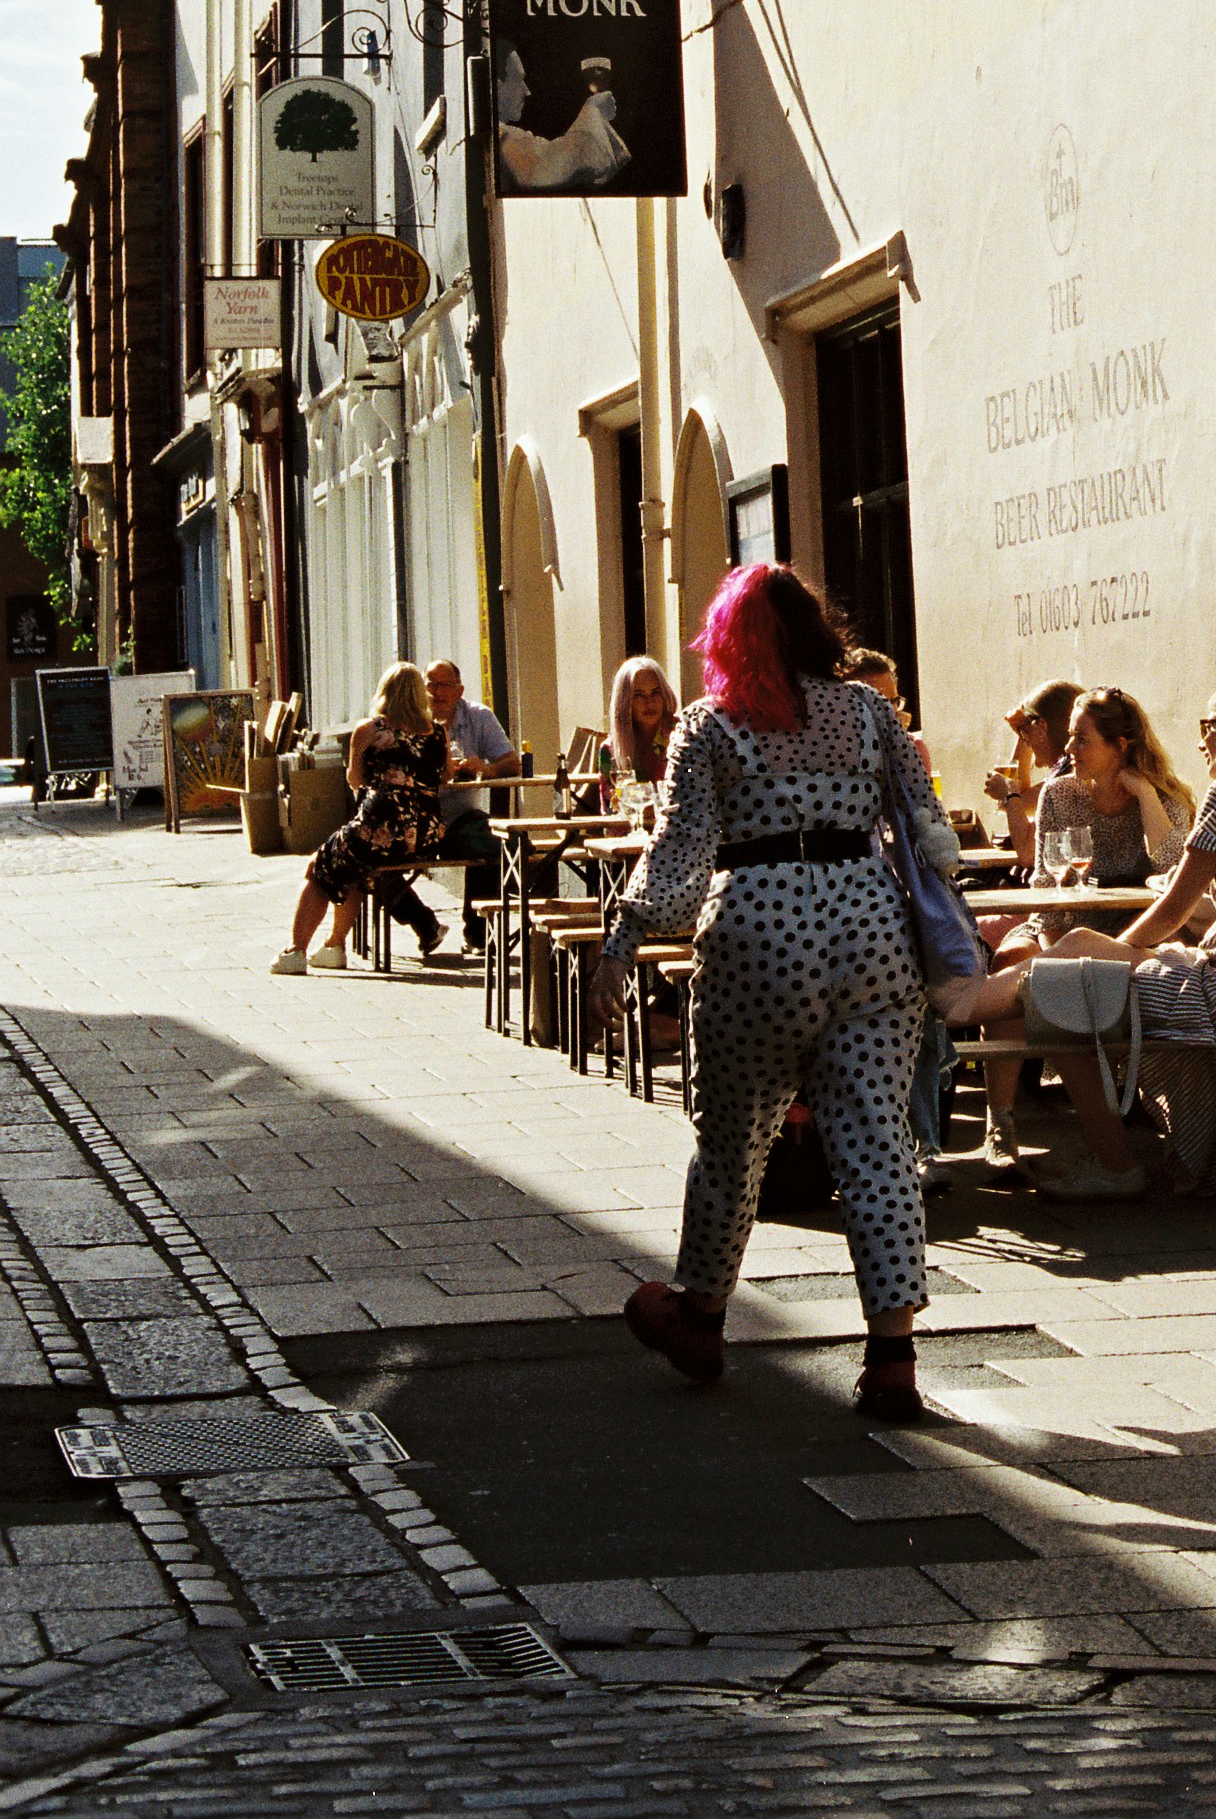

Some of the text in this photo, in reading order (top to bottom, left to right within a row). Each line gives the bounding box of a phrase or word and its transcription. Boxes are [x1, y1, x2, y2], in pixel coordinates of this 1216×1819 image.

[279, 185, 355, 197] Dental Practice
[281, 200, 327, 212] Norwich
[277, 213, 316, 226] Implant
[326, 239, 419, 277] POTTERGATE
[214, 285, 271, 302] Norfolk
[226, 301, 259, 315] Yarn
[327, 276, 421, 318] PANTRY
[1047, 272, 1085, 335] THE
[985, 336, 1171, 455] BELGIAN MONK
[994, 458, 1167, 550] BEER RESTAURANT
[1013, 570, 1152, 637] Tel 01603 767222
